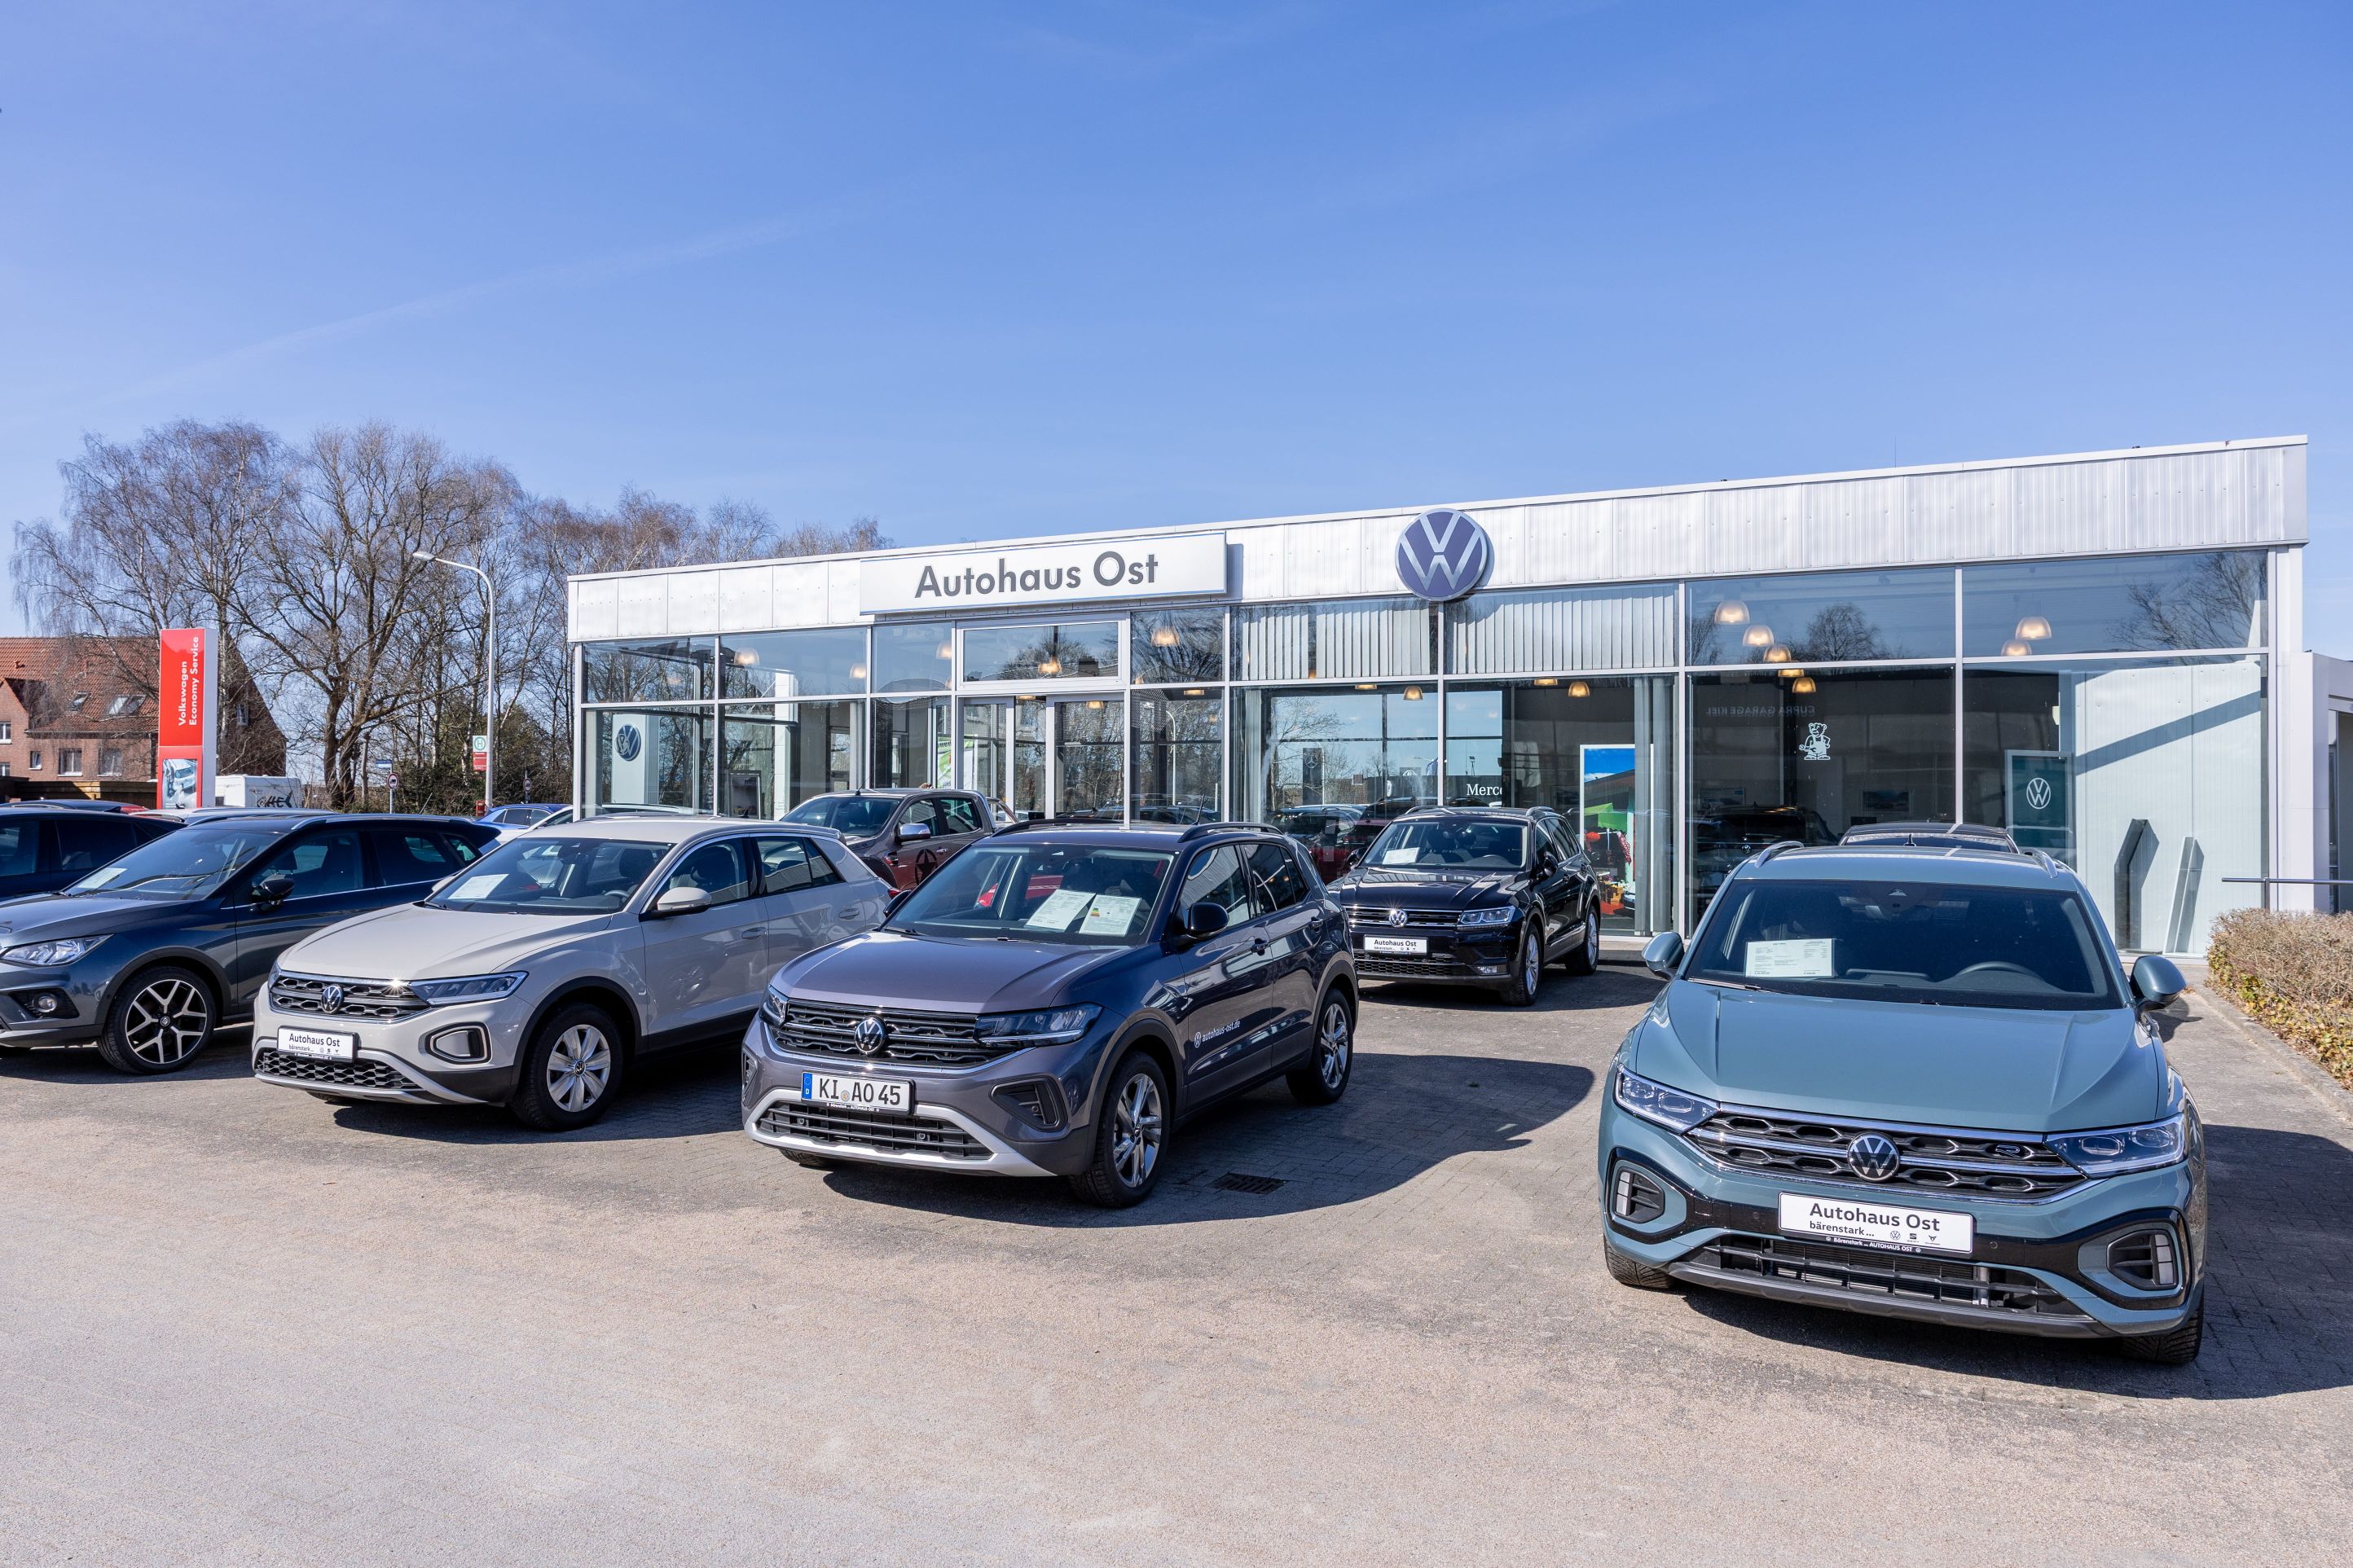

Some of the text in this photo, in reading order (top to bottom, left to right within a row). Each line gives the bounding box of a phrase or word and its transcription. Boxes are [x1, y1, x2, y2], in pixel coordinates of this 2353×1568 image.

[1395, 508, 1488, 601] VW
[915, 551, 1158, 598] Autohaus Ost
[178, 661, 188, 726] Volkswagen
[189, 636, 200, 725] Economy Service
[1467, 783, 1502, 796] Merc
[2026, 777, 2051, 810] VW
[288, 1033, 341, 1047] Autohaus Ost
[1202, 1019, 1240, 1042] autohaus-ost.de
[820, 1078, 901, 1105] KI AO 45
[1810, 1203, 1940, 1232] Autohaus Ost
[1869, 1242, 1900, 1251] AUTOHAUS
